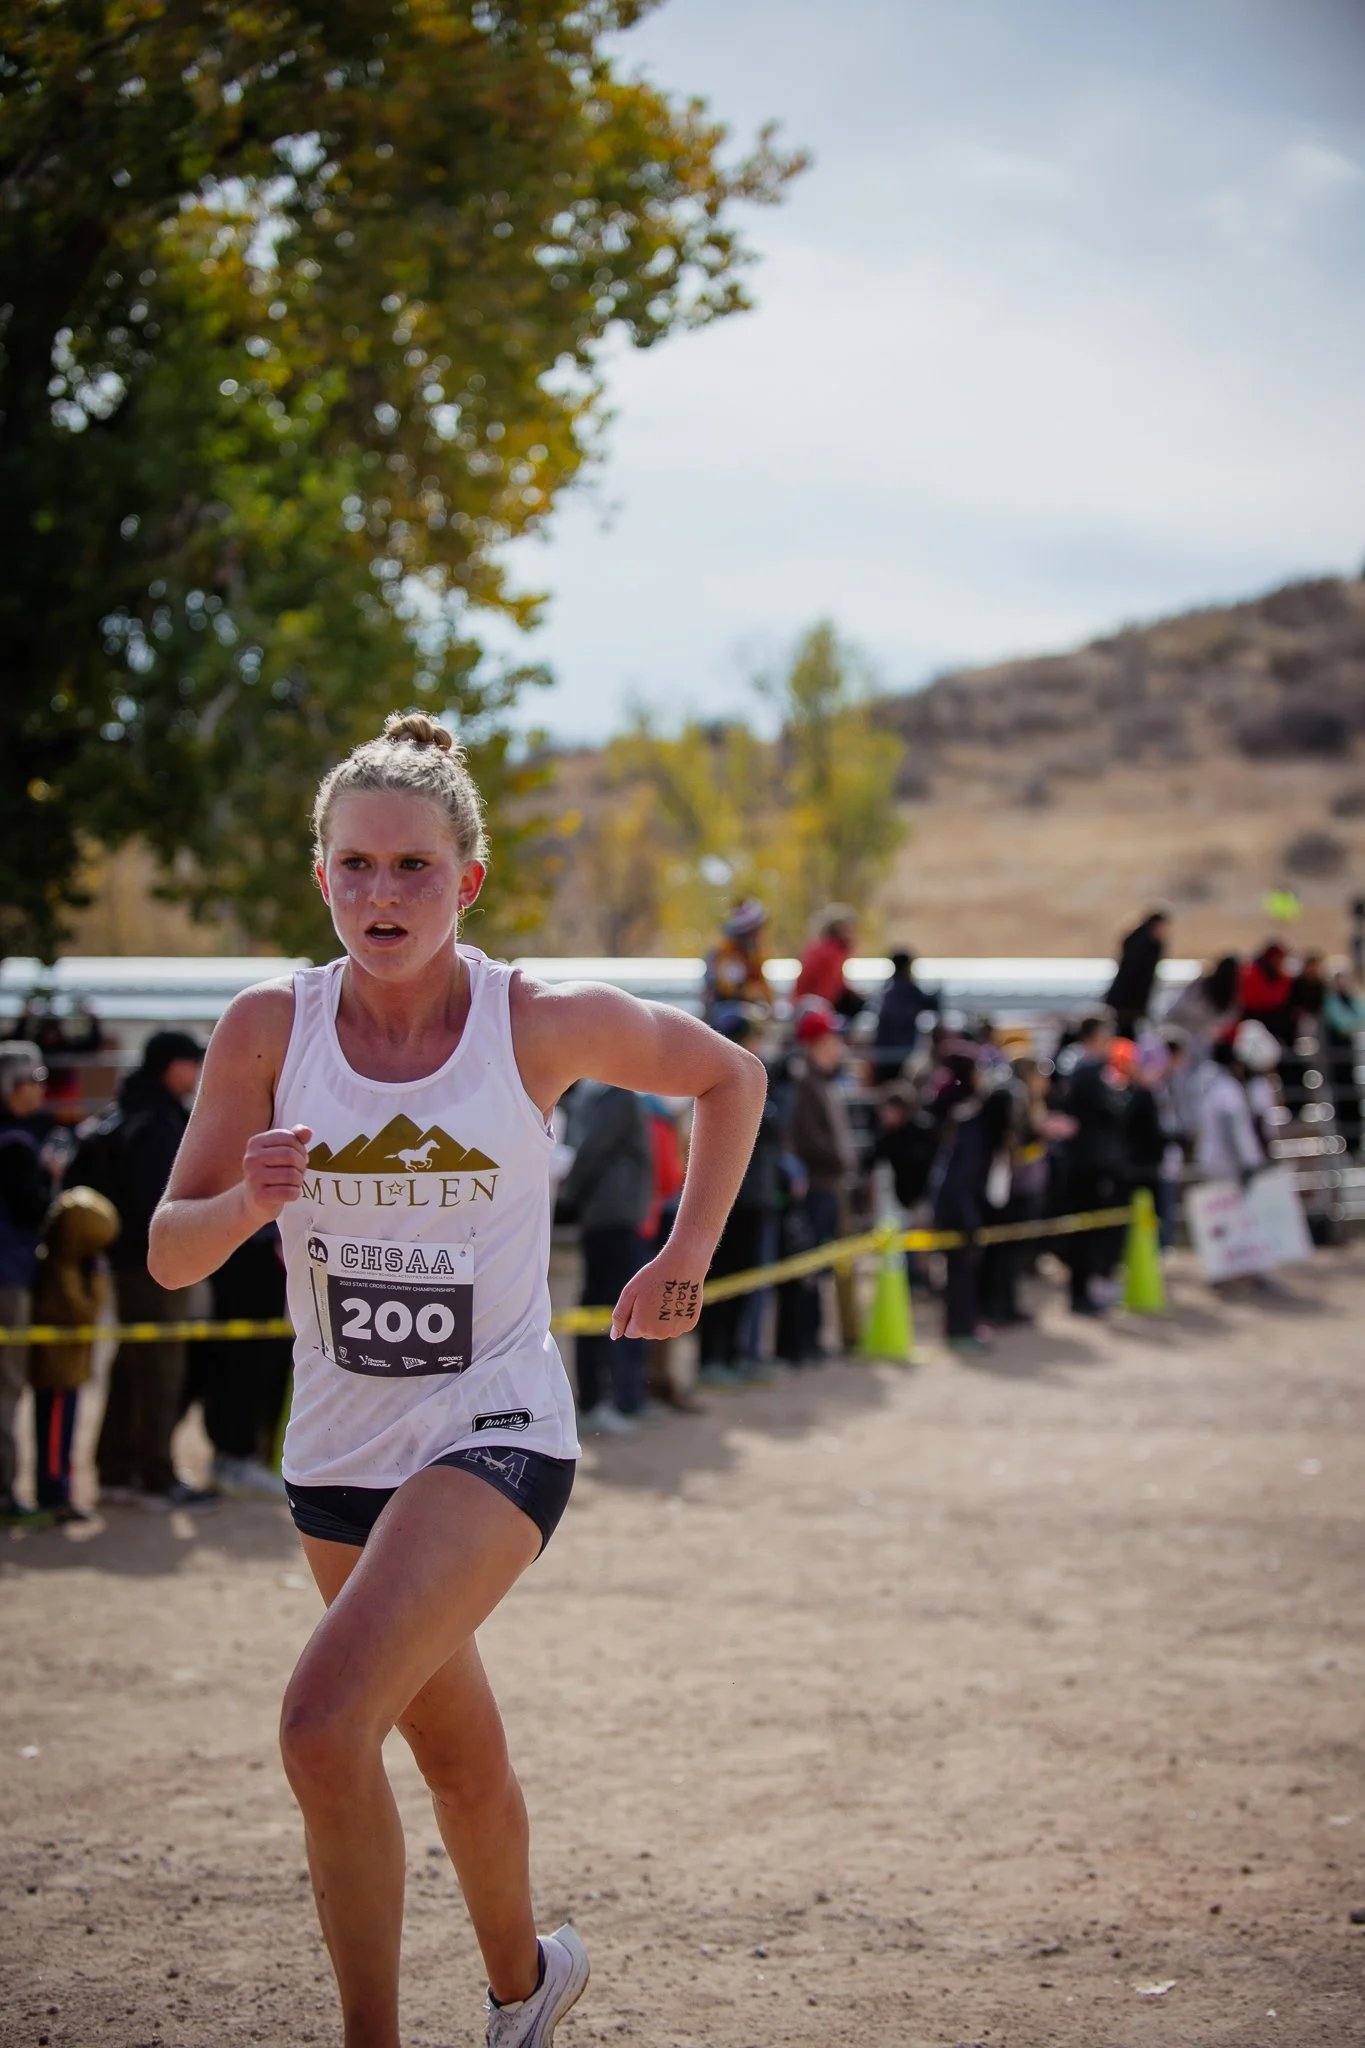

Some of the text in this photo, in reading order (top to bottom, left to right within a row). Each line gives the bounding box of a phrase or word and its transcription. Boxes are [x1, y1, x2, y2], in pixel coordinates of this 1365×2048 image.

[301, 1174, 499, 1207] MULLEN
[310, 1243, 327, 1262] 4A
[341, 1243, 455, 1275] CHSAA
[658, 1280, 677, 1320] DOWN
[685, 1282, 699, 1319] DONT
[340, 1298, 455, 1343] 200
